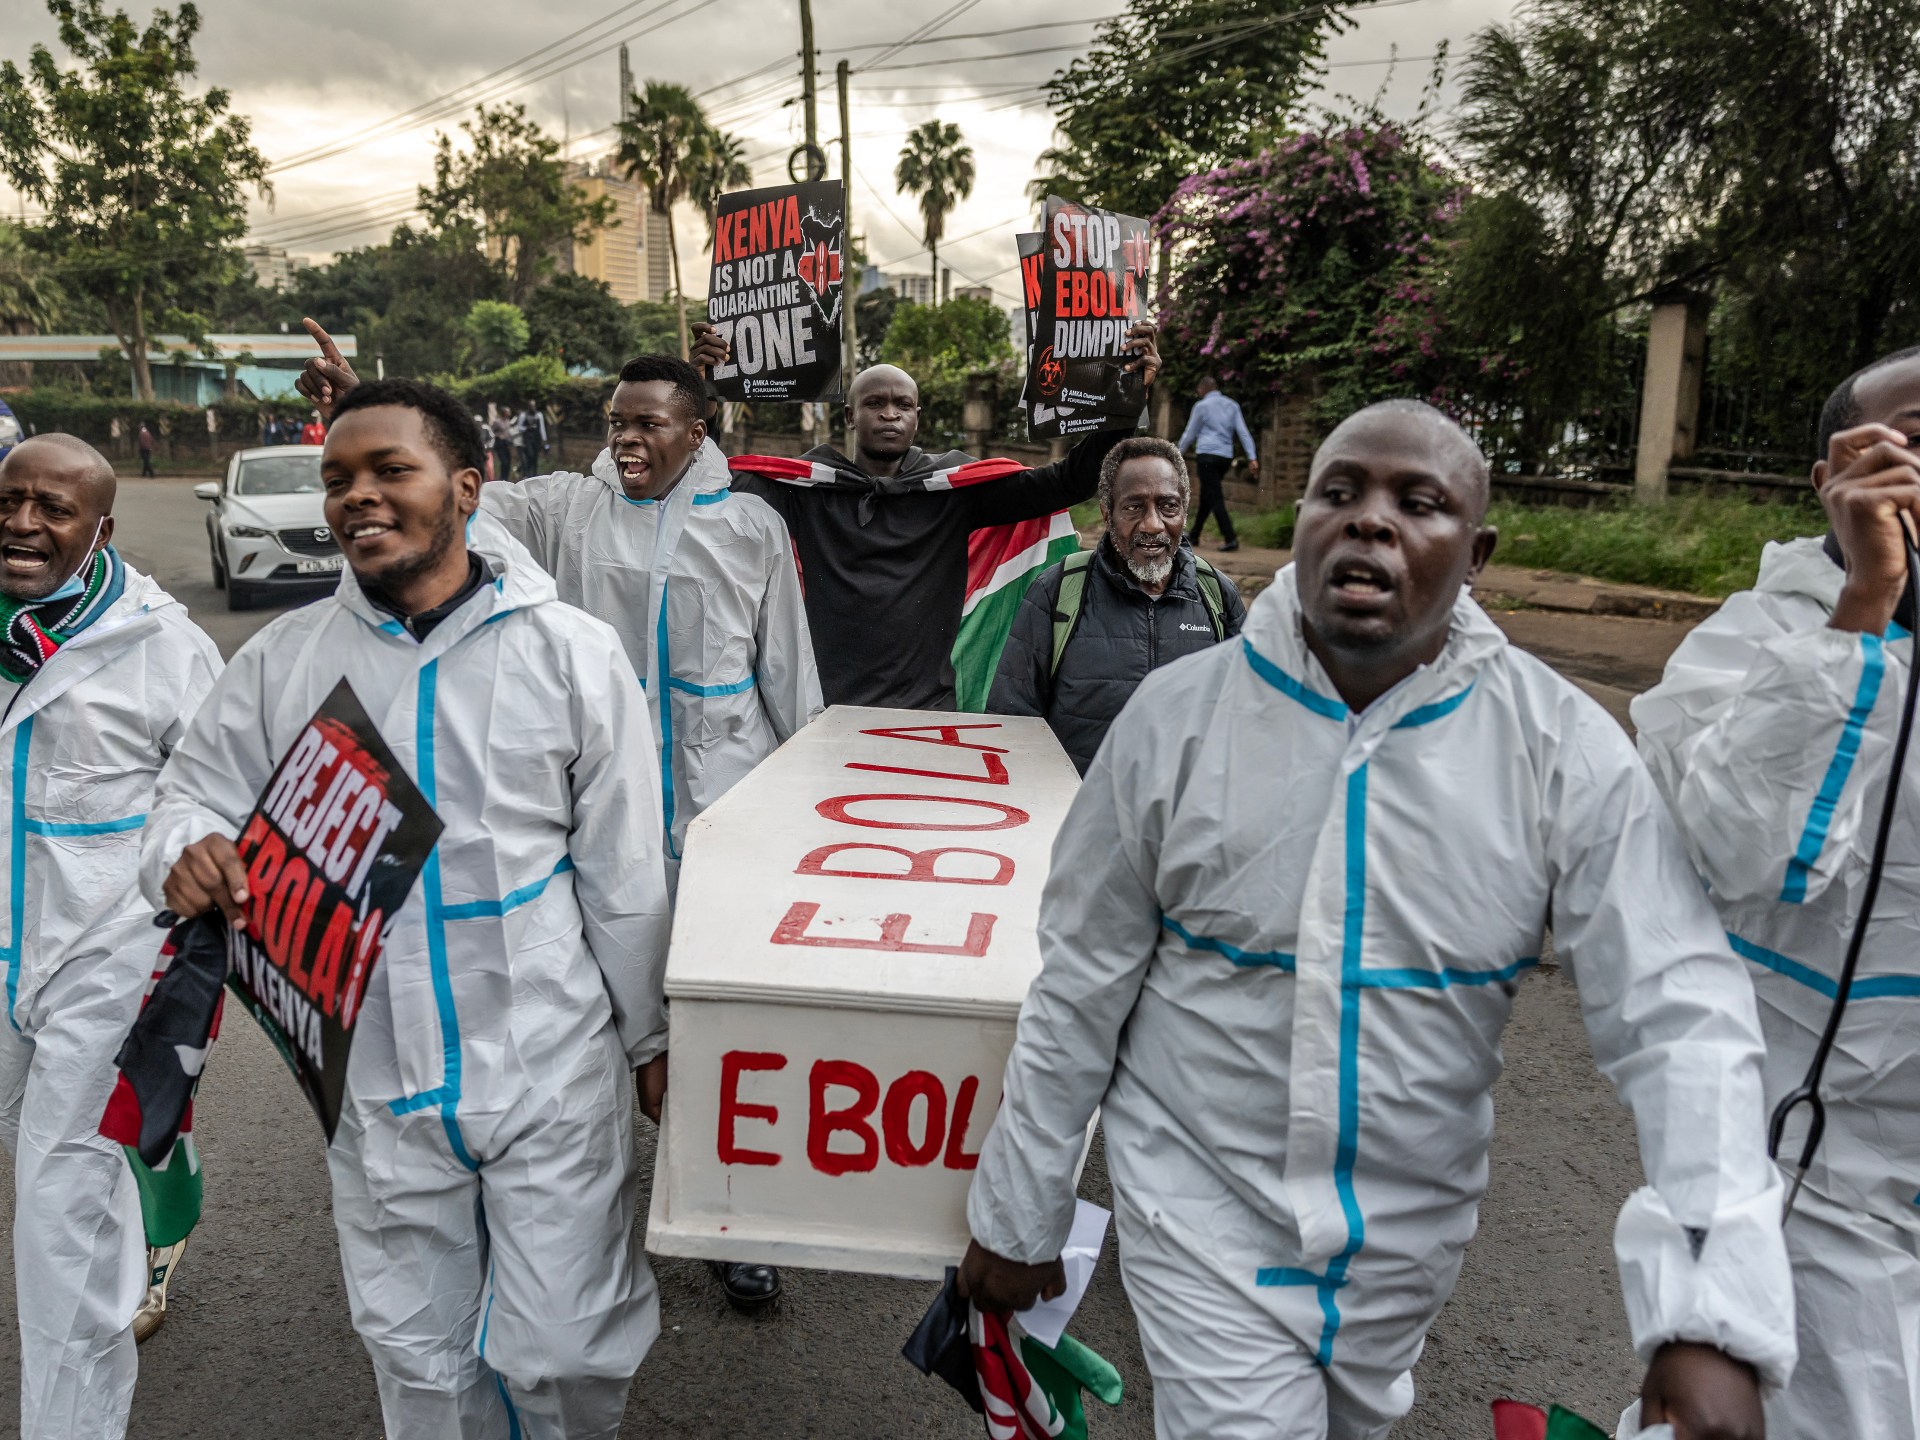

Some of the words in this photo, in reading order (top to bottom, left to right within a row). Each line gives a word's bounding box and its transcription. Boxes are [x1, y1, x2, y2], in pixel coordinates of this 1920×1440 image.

[715, 195, 802, 264] KENYA
[1053, 212, 1121, 269] STOP
[715, 264, 733, 293] IS
[738, 253, 777, 288] NOT
[782, 250, 797, 279] A
[709, 280, 800, 322] QUARANTINE
[1055, 271, 1139, 318] EBOLA
[713, 304, 817, 380] ZONE
[1053, 320, 1143, 359] DUMPIN
[752, 379, 769, 387] AMKA
[1068, 389, 1082, 398] AMKA
[1067, 419, 1082, 427] AMKA
[1186, 623, 1211, 633] Columbia
[263, 725, 404, 901] REJECT
[769, 723, 1030, 958] EBOLA
[251, 945, 324, 1071] KENYA
